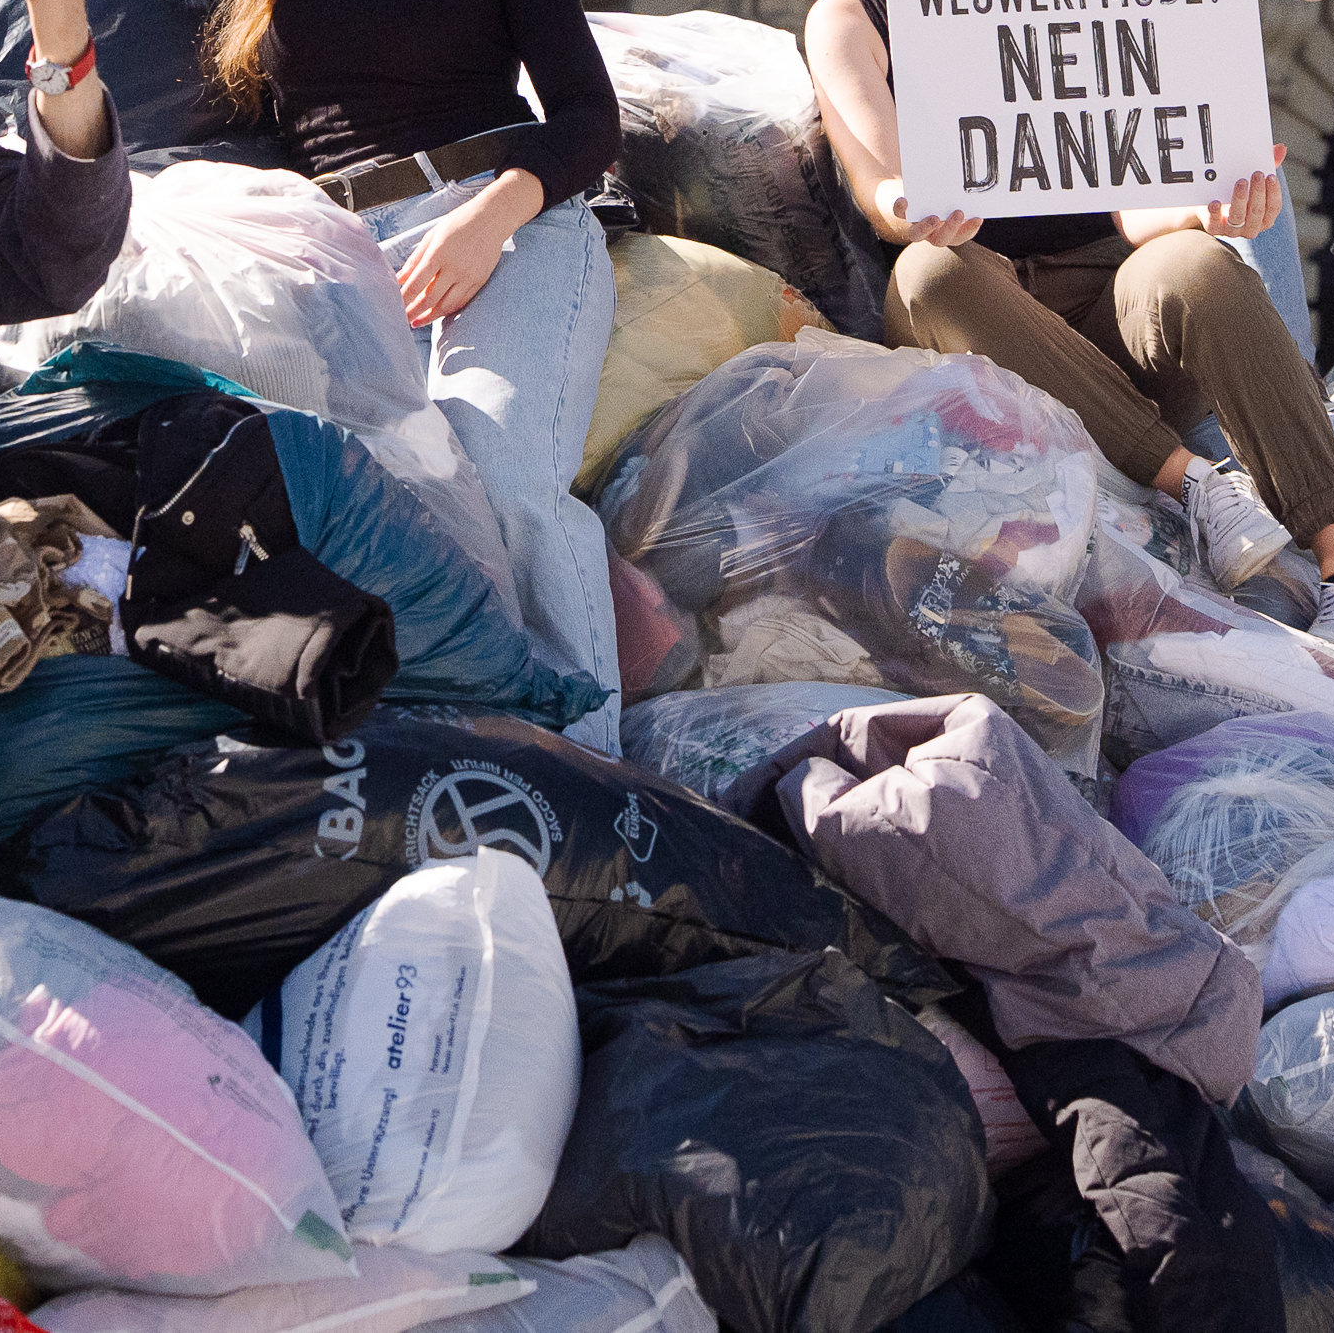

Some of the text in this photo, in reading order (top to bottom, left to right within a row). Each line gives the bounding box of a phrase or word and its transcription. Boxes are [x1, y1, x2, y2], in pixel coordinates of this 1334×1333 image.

[997, 18, 1161, 103] NEIN
[958, 103, 1217, 193] DANKE!
[503, 767, 531, 792] PER
